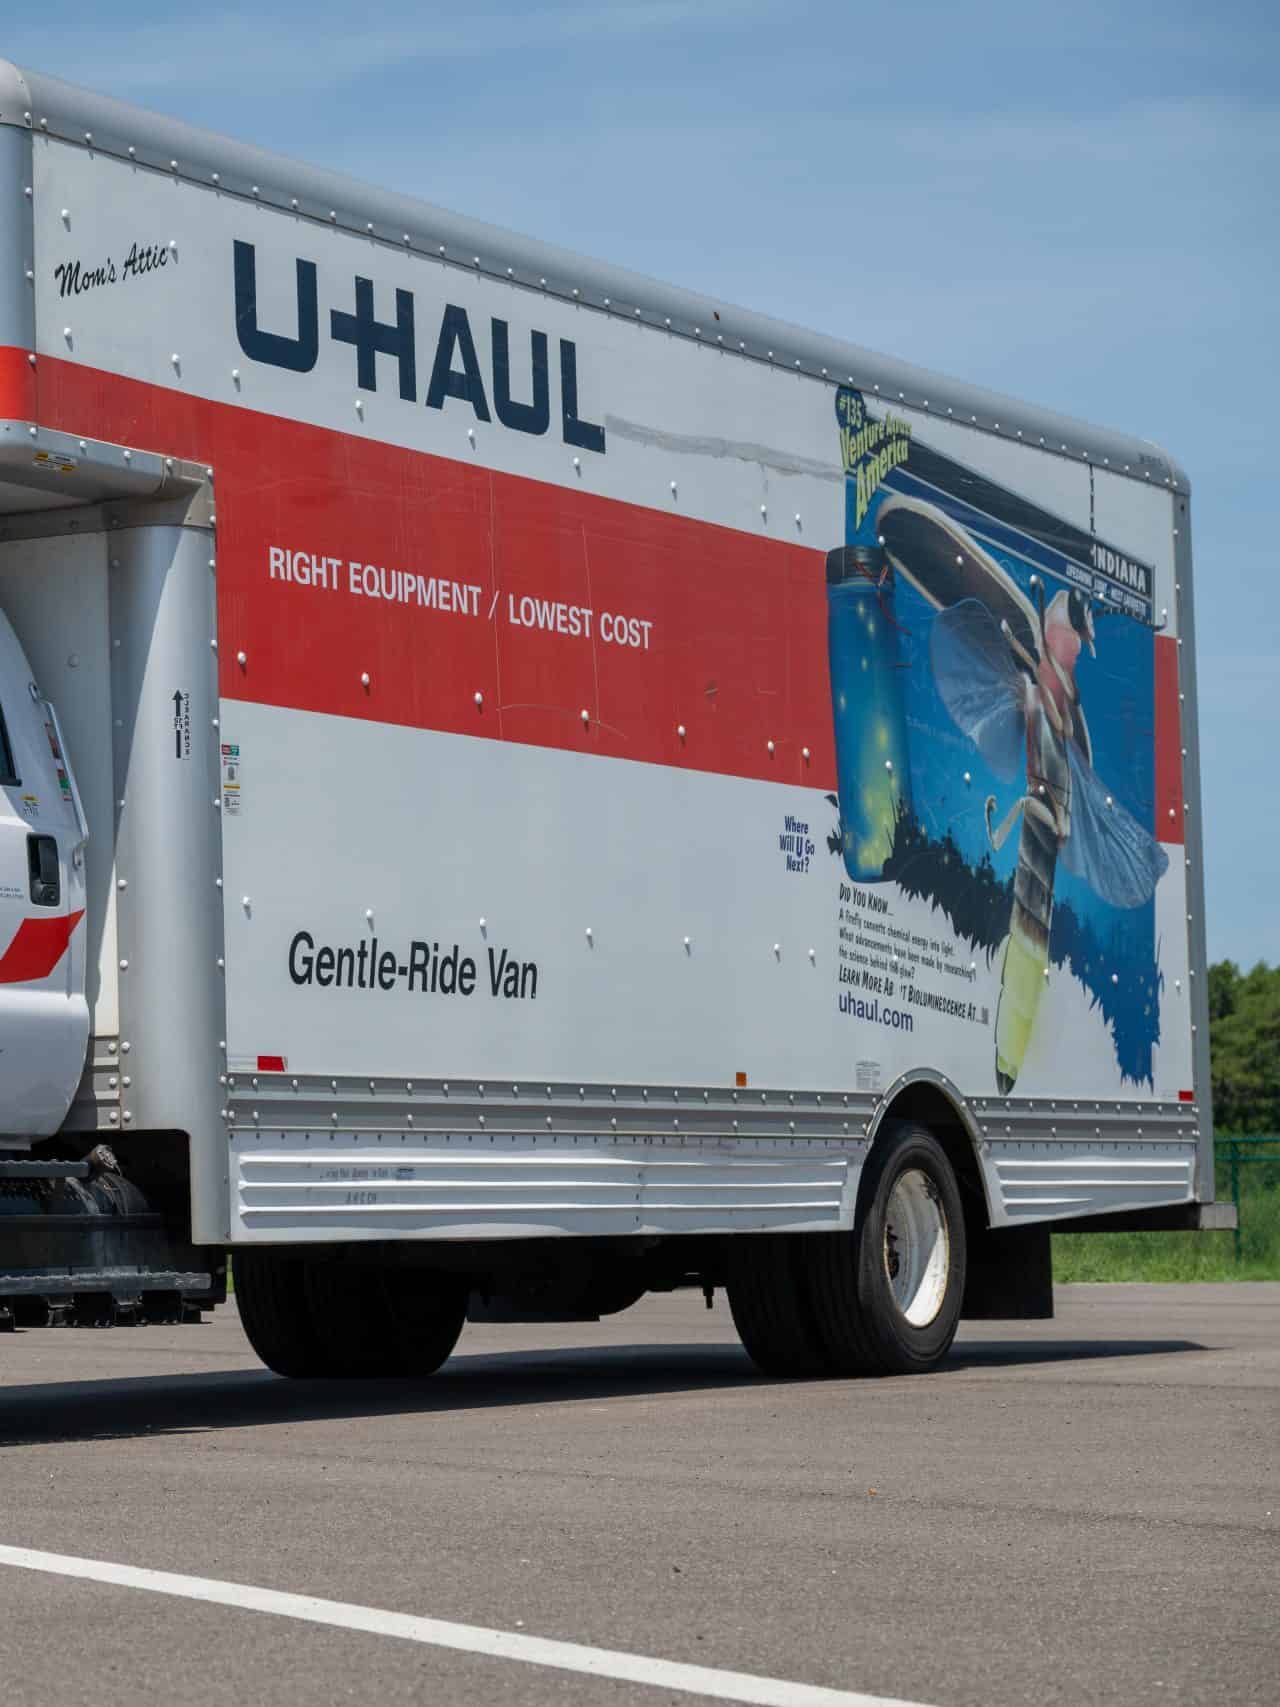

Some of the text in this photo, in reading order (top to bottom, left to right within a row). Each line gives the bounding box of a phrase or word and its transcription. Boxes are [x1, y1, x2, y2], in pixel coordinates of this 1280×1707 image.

[54, 241, 168, 298] Mom's Attic
[839, 394, 862, 428] #135
[840, 419, 884, 473] Venture
[855, 438, 908, 531] America
[1089, 543, 1146, 593] INDIANA
[268, 546, 653, 650] RIGHT EQUIPMENT / LOWEST COST
[779, 833, 815, 858] Will U Go
[784, 816, 808, 834] Where
[786, 854, 810, 873] Next?
[288, 931, 539, 999] Gentle-Ride Van
[839, 964, 861, 986] LEARN
[862, 969, 882, 993] MORE
[839, 990, 913, 1032] uhaul.com
